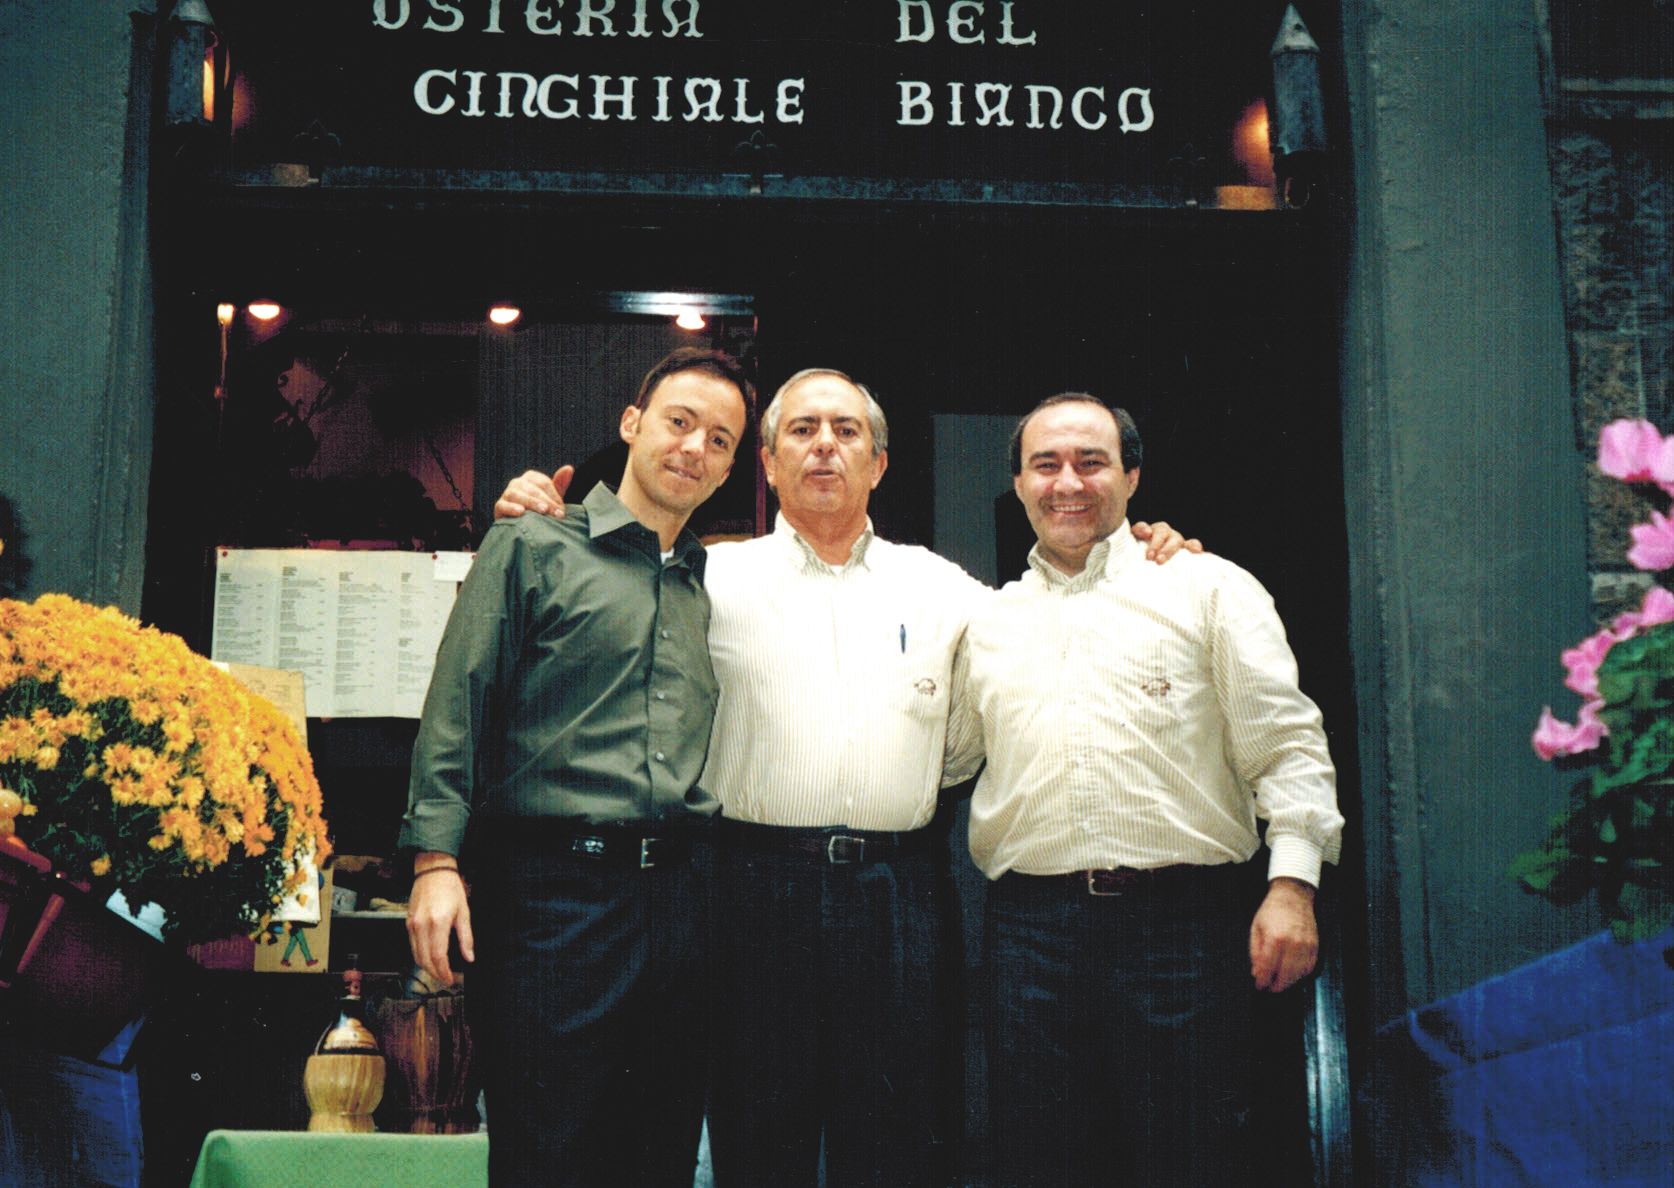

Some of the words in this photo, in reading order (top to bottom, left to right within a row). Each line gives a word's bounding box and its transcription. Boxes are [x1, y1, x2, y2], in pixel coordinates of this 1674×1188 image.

[895, 0, 1037, 46] DEL
[413, 69, 805, 125] CINGHIALE
[896, 81, 1155, 134] BIANCO
